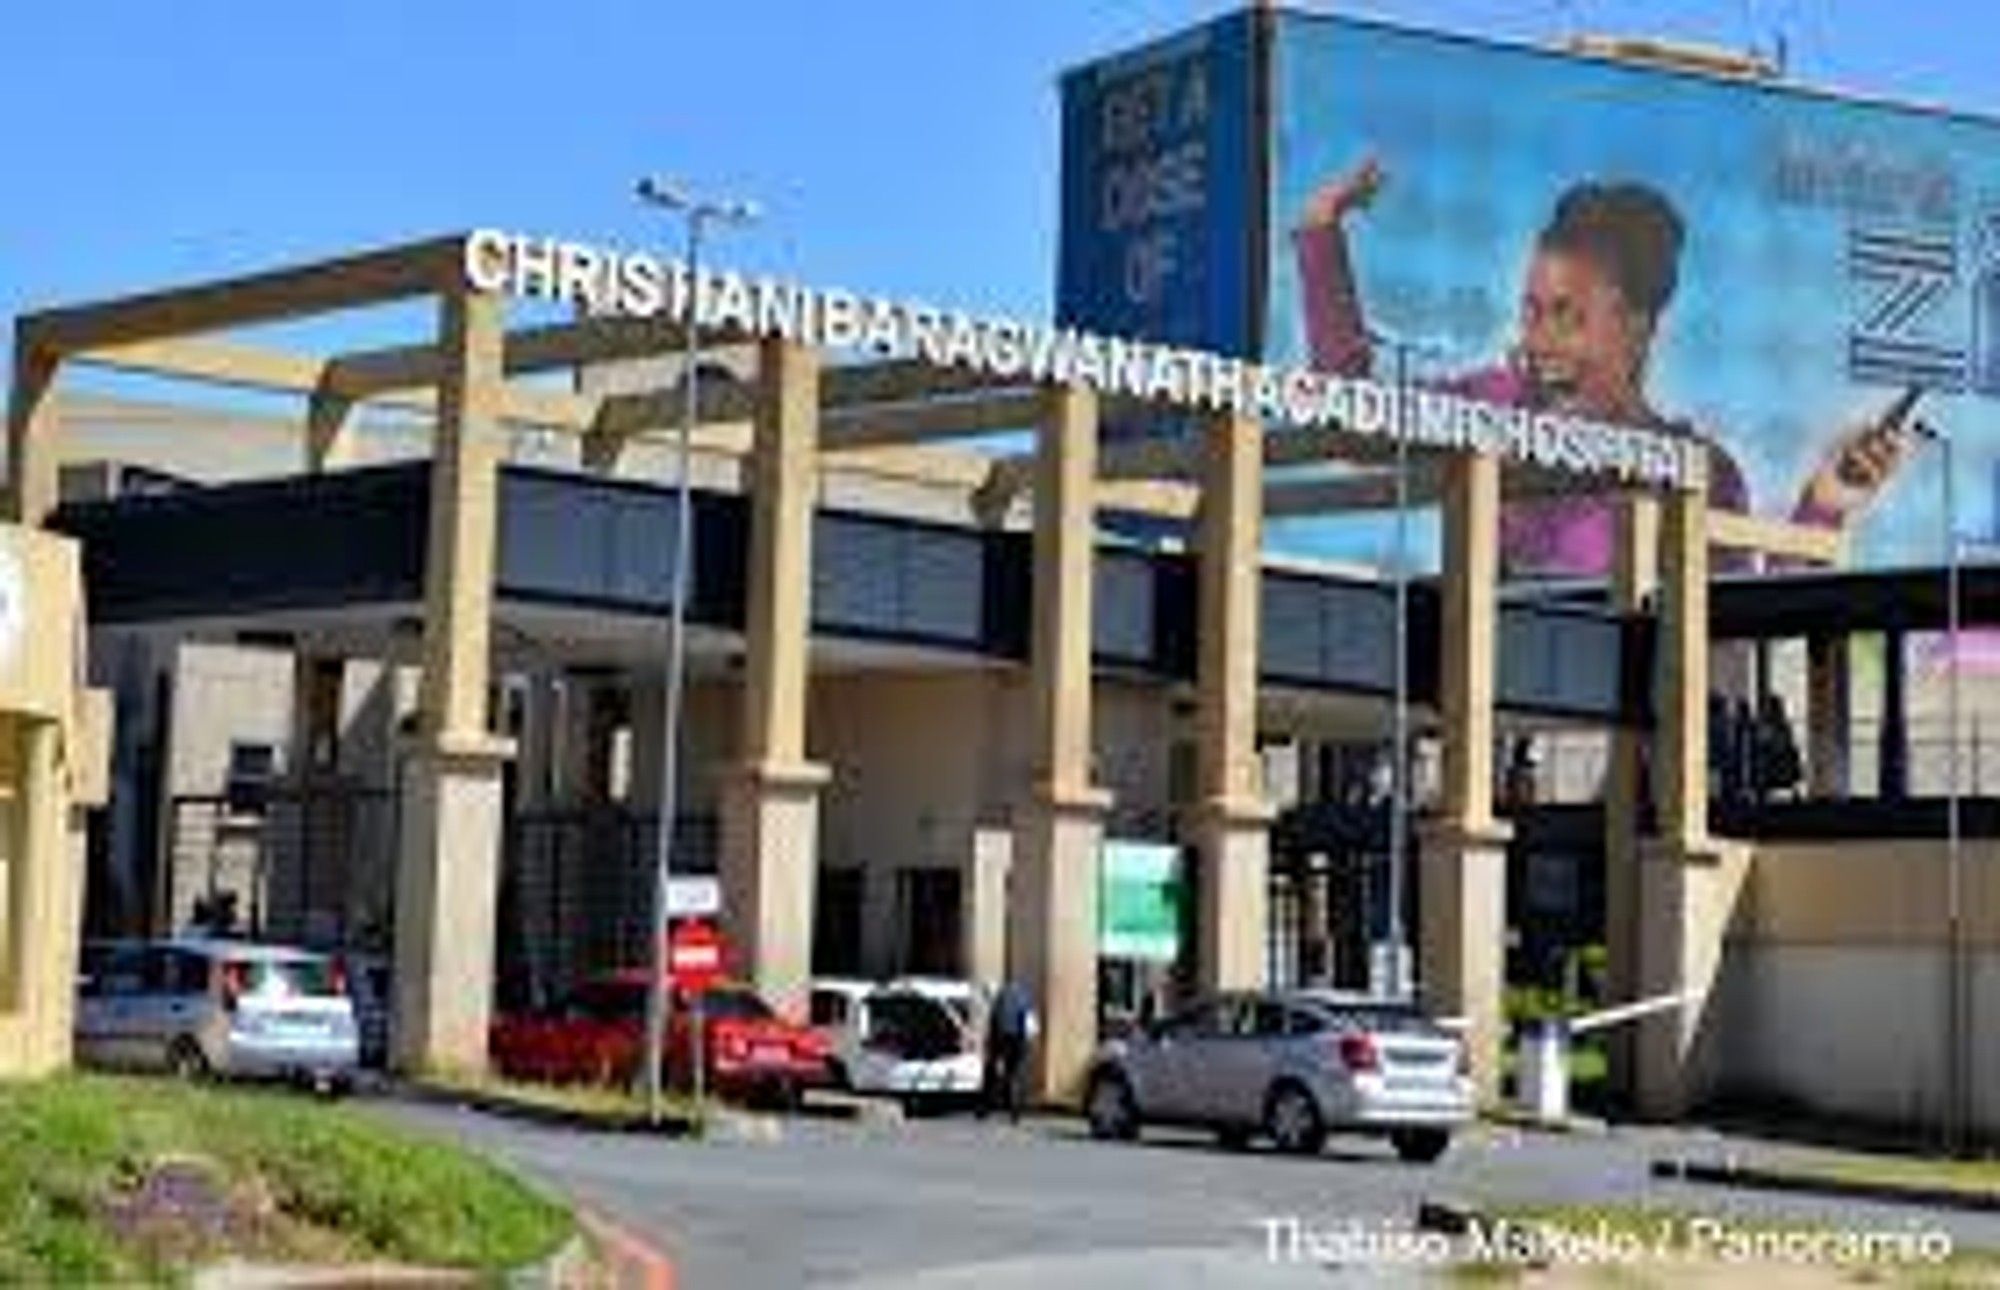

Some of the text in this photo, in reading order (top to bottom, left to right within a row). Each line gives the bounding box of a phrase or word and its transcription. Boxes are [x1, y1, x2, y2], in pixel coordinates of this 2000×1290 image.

[466, 229, 667, 317] CHRIS
[671, 258, 812, 343] HANI
[824, 287, 1242, 410] BARAGWANATH
